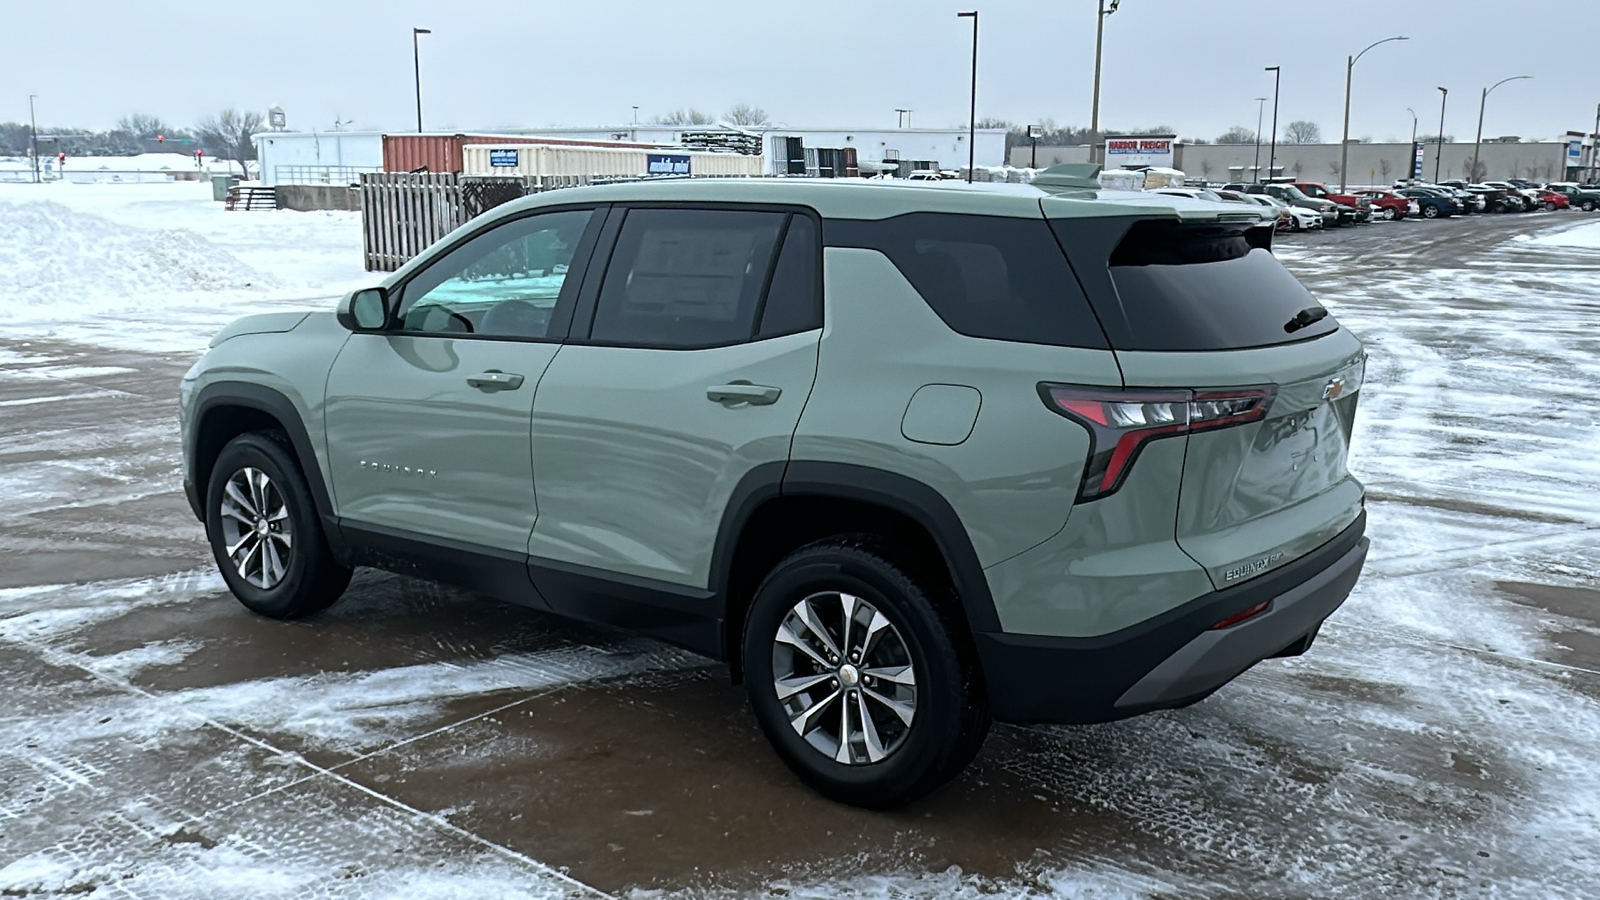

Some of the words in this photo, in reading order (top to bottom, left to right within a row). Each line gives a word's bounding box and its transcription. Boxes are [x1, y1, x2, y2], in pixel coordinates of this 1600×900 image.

[1108, 140, 1138, 150] HARBOR
[1140, 140, 1171, 150] FREIGHT
[360, 460, 437, 479] EQUINOX
[1225, 557, 1269, 581] EQUINOX
